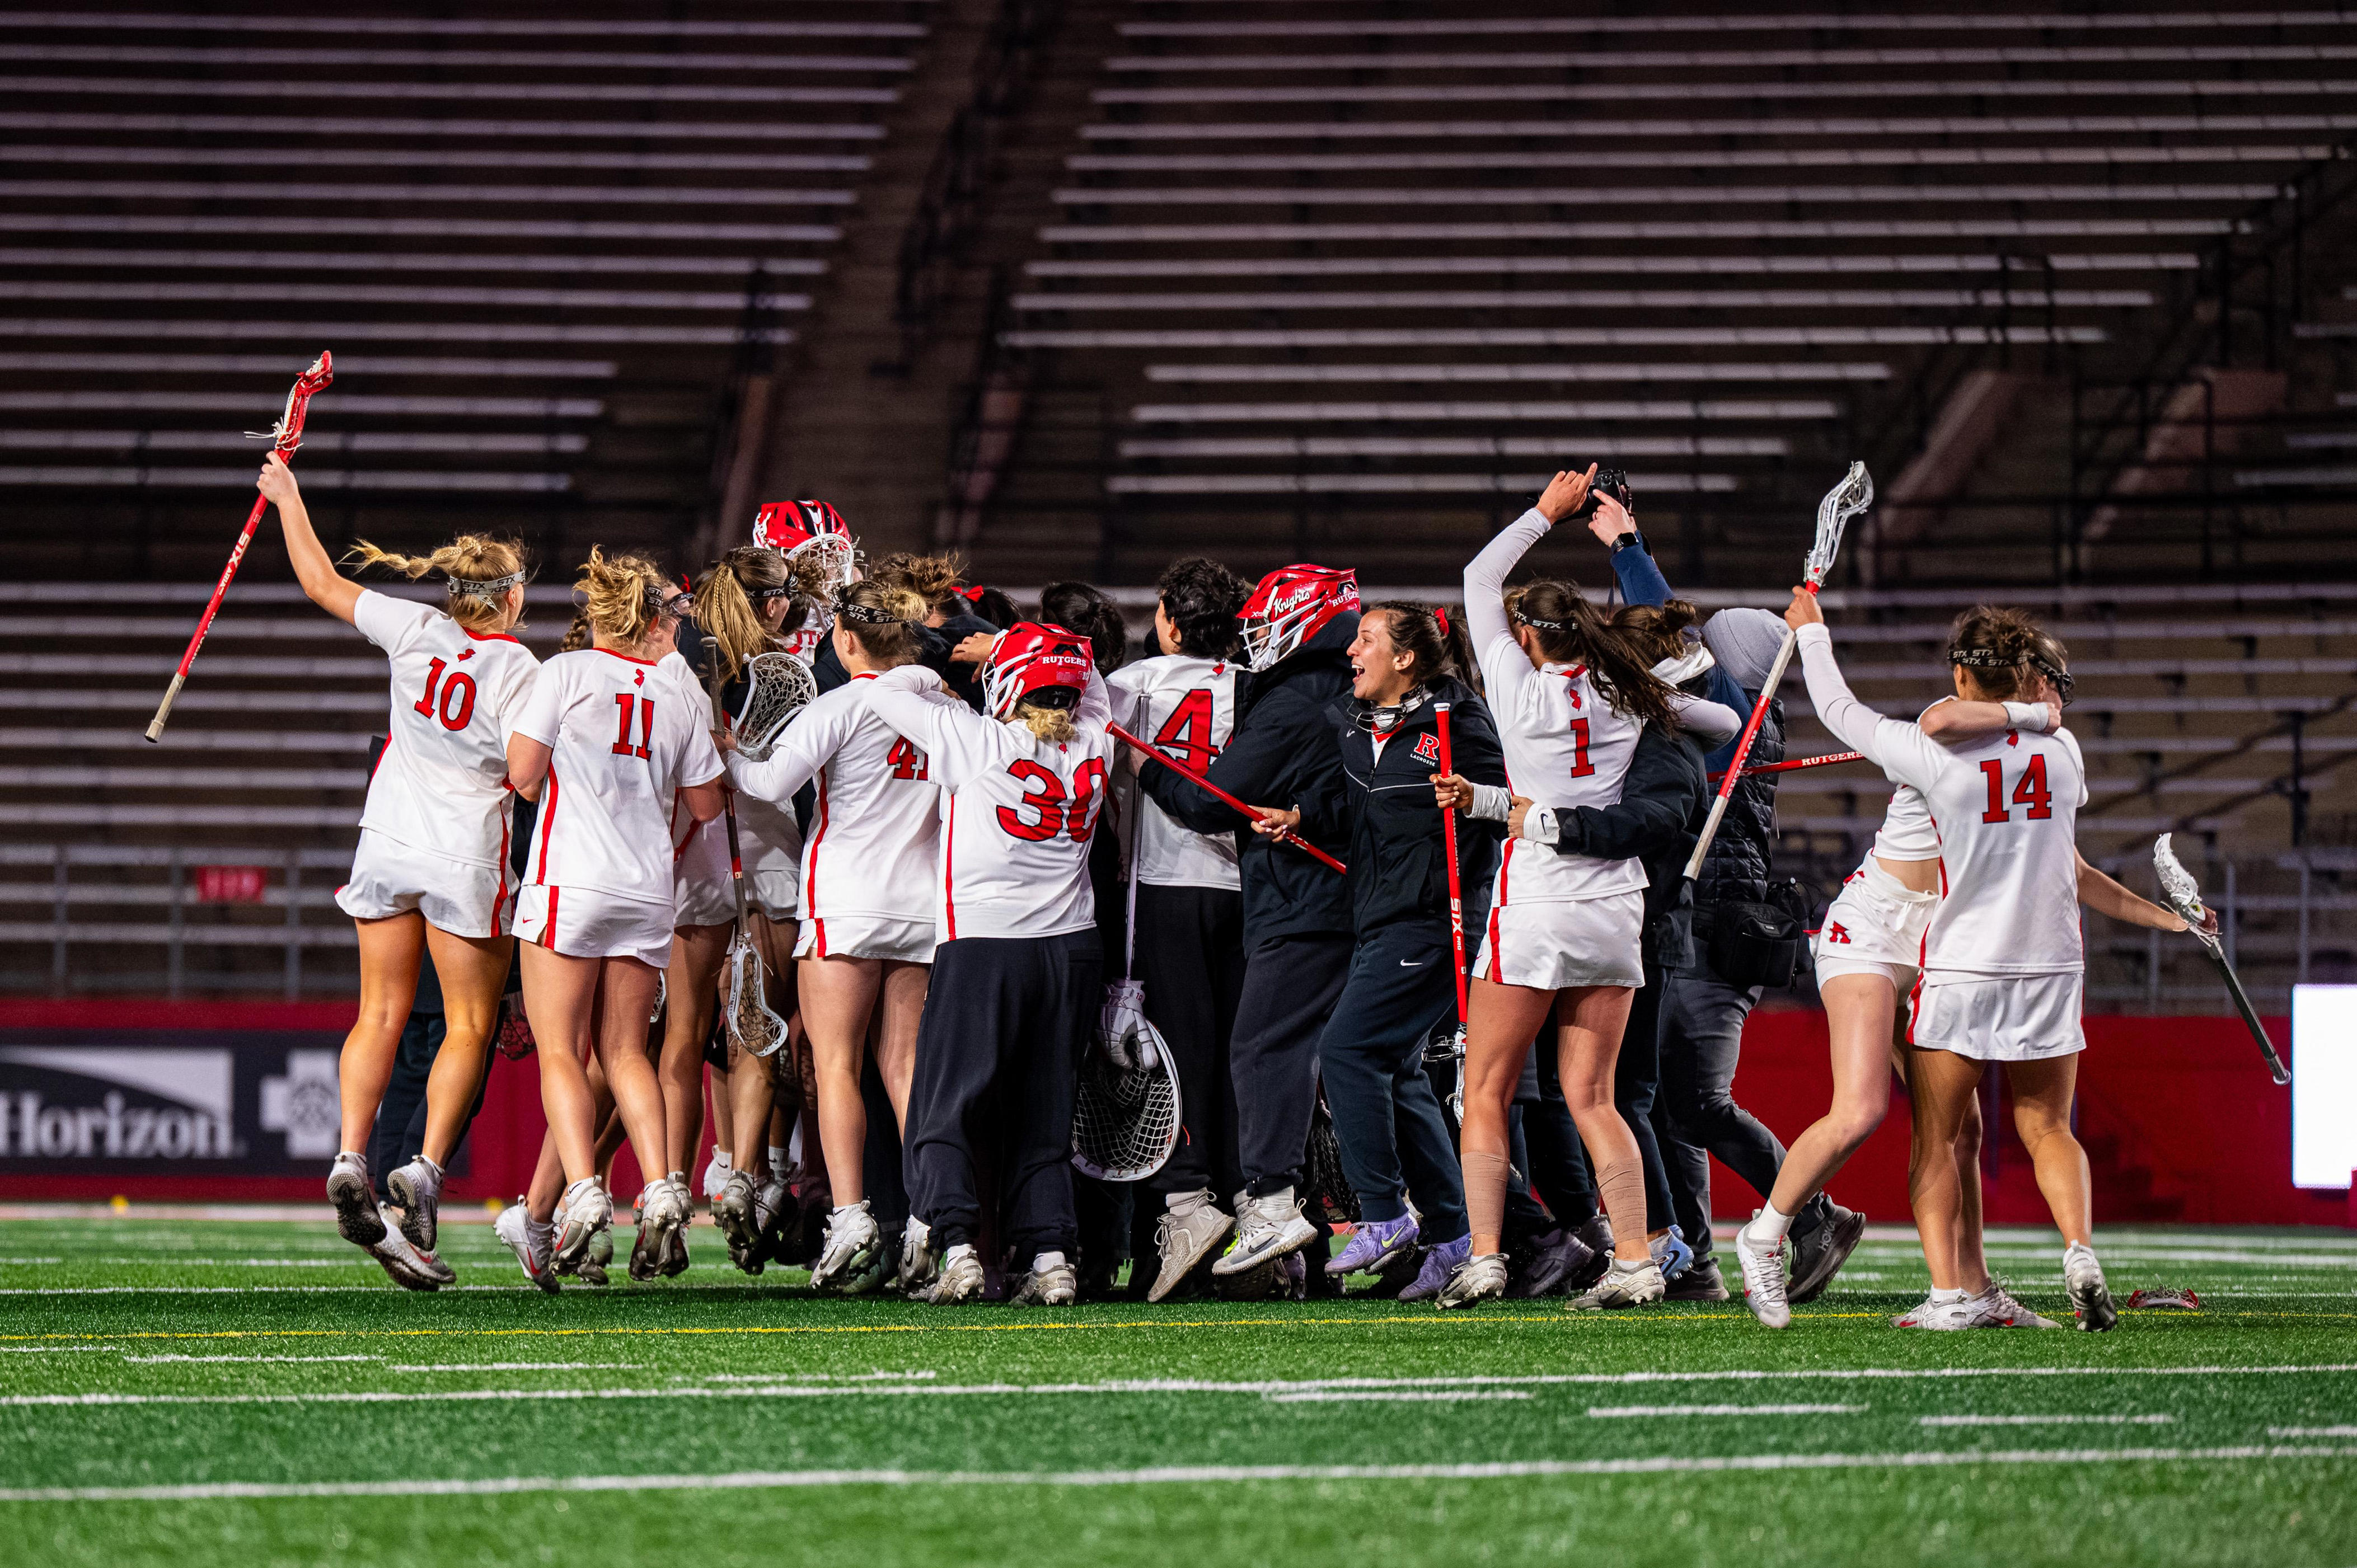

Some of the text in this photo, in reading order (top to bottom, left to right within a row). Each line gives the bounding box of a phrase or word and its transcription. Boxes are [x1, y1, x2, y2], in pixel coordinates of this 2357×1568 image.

[228, 531, 250, 568] STX
[497, 575, 515, 586] STX
[763, 587, 785, 596] STX
[847, 604, 868, 614] STX
[849, 612, 869, 622] STX
[1273, 589, 1310, 618] Knights
[1532, 619, 1561, 629] STX
[1042, 656, 1086, 667] RUTGERS
[414, 656, 477, 731] 10
[612, 693, 655, 762] 11
[1154, 689, 1234, 777] 4
[1410, 754, 1435, 766] LACROSSE
[1414, 732, 1440, 760] R
[1570, 717, 1595, 778] 1
[996, 755, 1109, 843] 30
[1980, 754, 2052, 824] 14
[1450, 897, 1464, 934] STX
[0, 1090, 231, 1157] Horizon
[1818, 1220, 1835, 1251] HOKA
